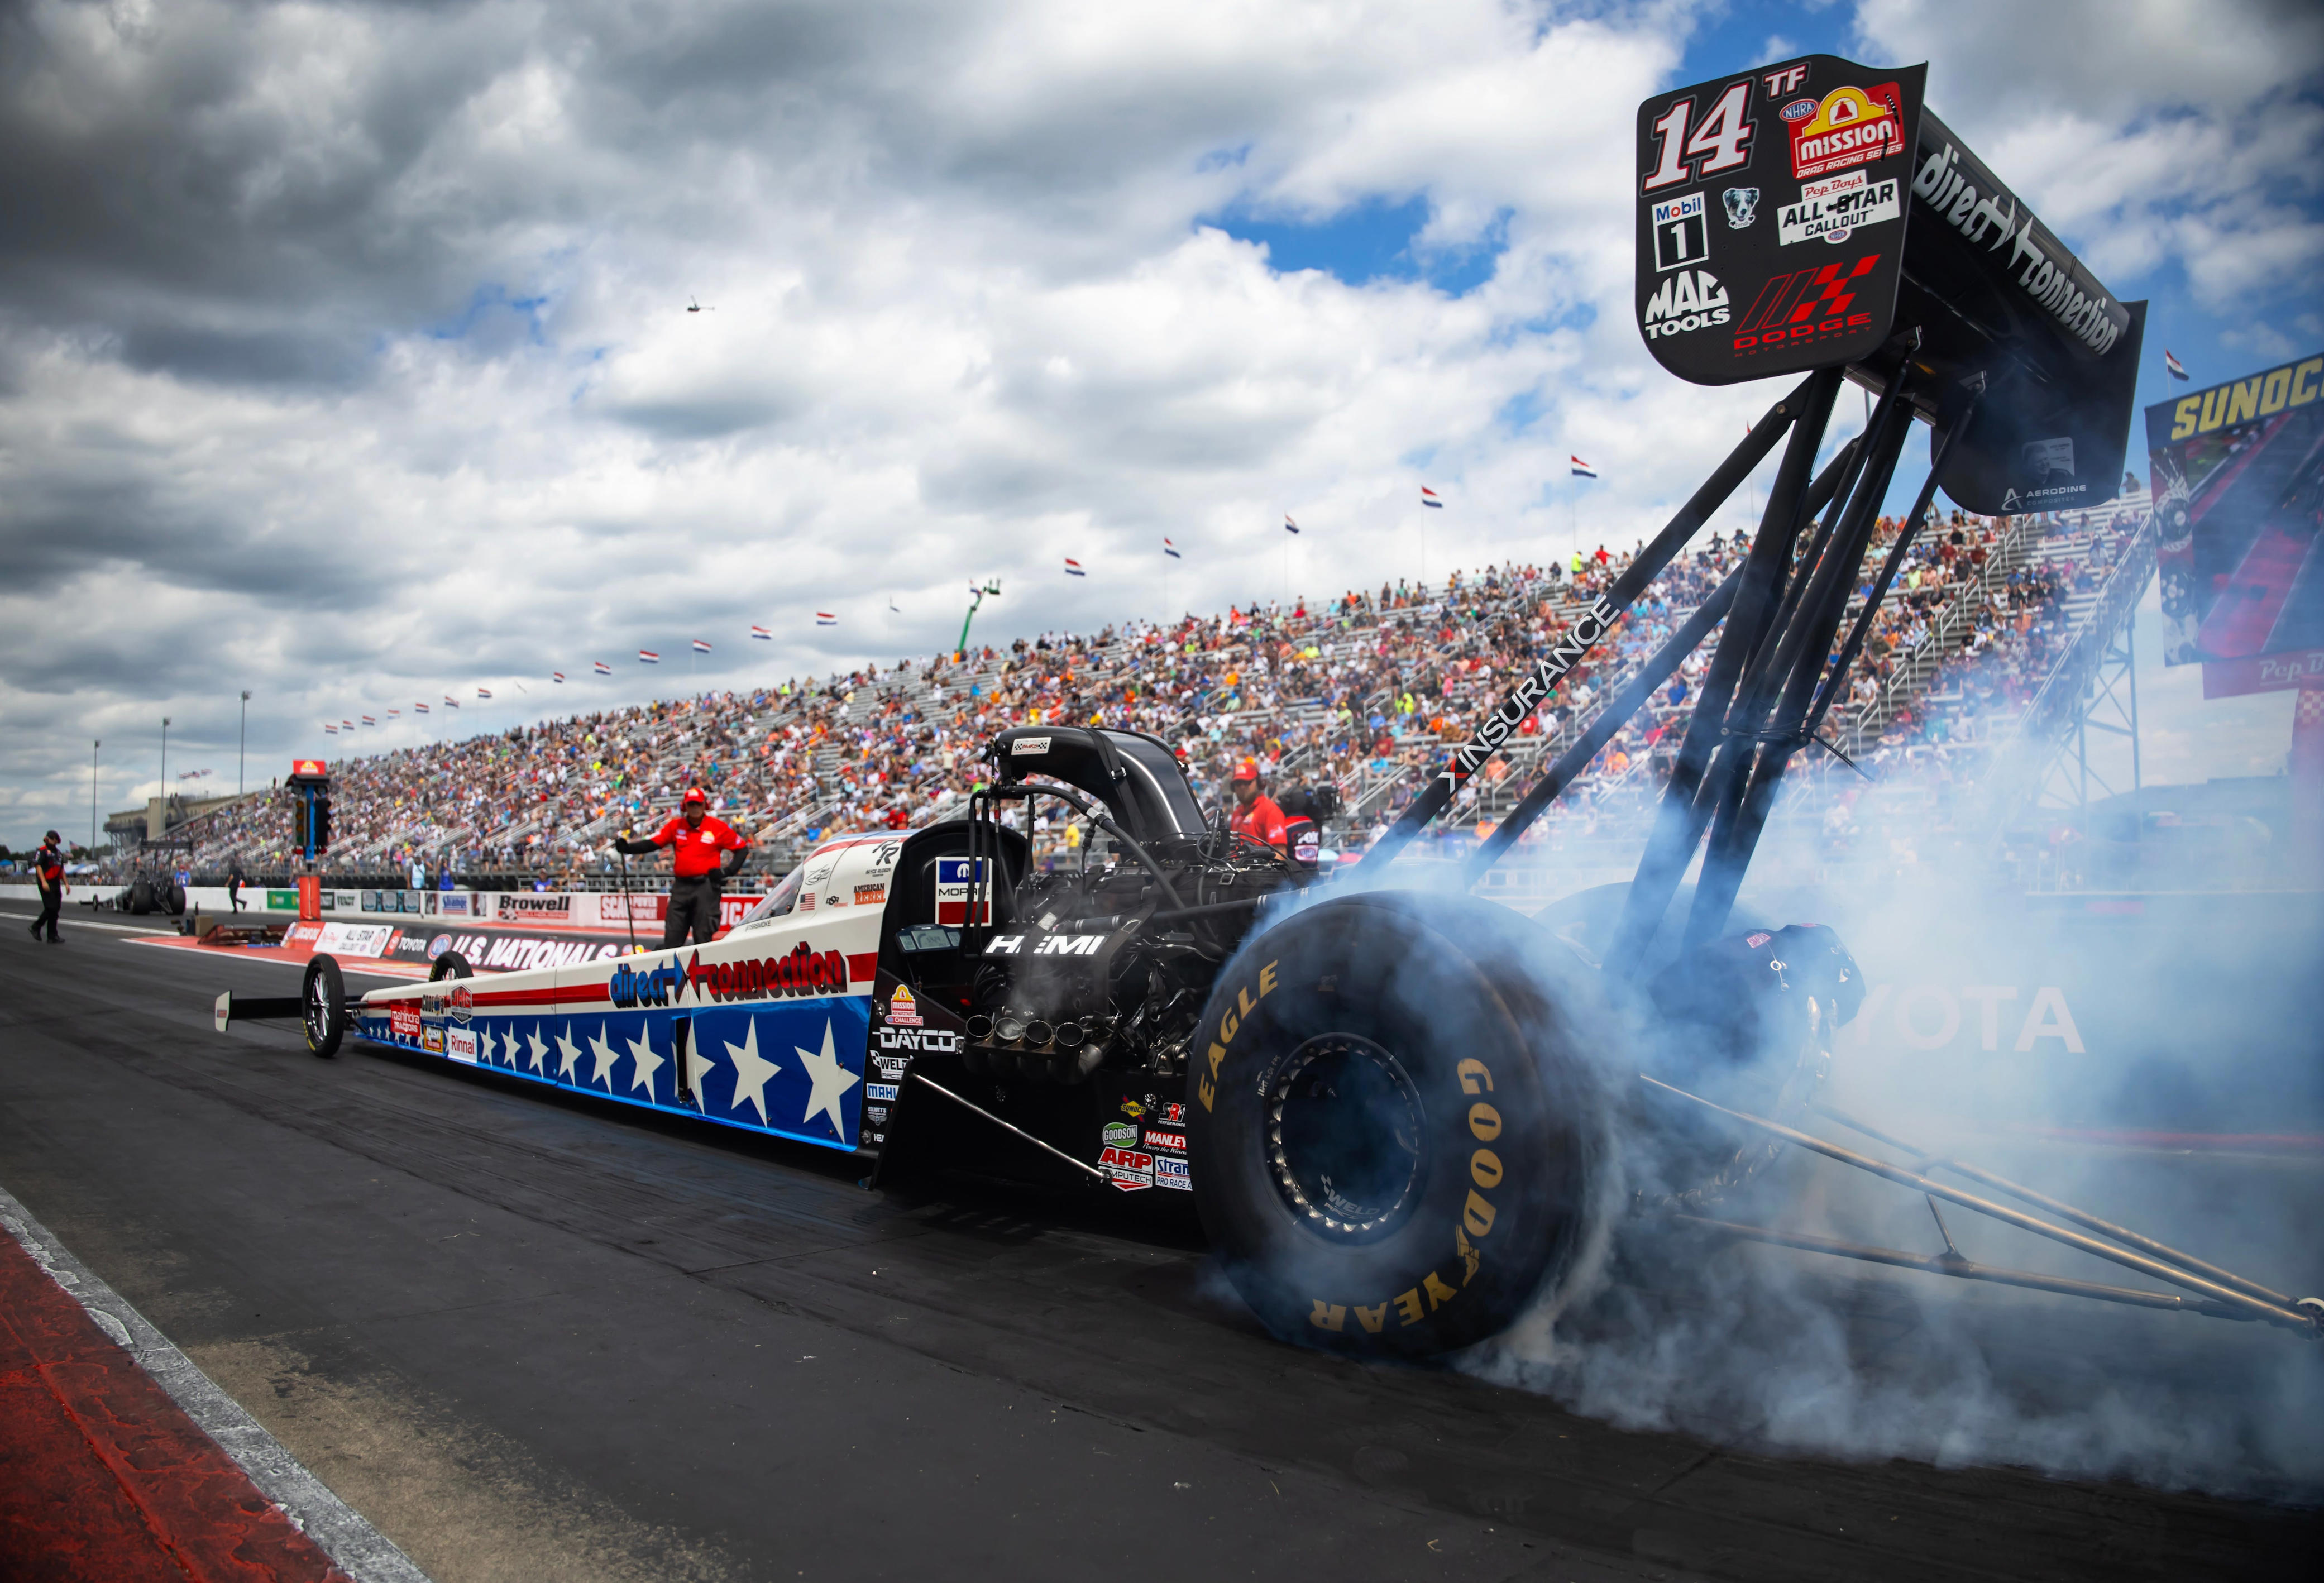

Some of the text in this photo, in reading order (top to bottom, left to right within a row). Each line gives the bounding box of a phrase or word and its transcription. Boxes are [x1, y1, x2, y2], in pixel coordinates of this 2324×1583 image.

[1764, 65, 1808, 97] TF
[1785, 102, 1815, 118] NHRA
[1644, 82, 1752, 191] 14
[1796, 165, 1824, 178] DRAG
[1826, 154, 1864, 170] RACING
[1804, 175, 1863, 197] Pep Boys
[1912, 142, 2010, 250] direct
[1656, 197, 1701, 222] Mobil
[1805, 211, 1869, 236] CALLOUT
[1671, 222, 1687, 260] 1
[1645, 270, 1729, 324] MAC
[2009, 218, 2118, 356] connection
[1645, 308, 1730, 339] TOOLS
[1734, 313, 1871, 350] DODGE
[1734, 327, 1871, 357] MOTORSPORT
[2171, 357, 2324, 442] SUNOC
[2026, 485, 2087, 498] AERODINE
[2027, 496, 2075, 506] COMPOSITES
[854, 883, 885, 893] AMERICAN
[854, 890, 886, 905] REBEL
[499, 895, 570, 911] Browell
[398, 936, 427, 952] TOYOTA
[610, 941, 847, 1008] direct connection
[392, 1010, 419, 1024] mahindra
[394, 1021, 418, 1032] TRACTORS
[451, 1035, 474, 1055] Rinnai
[879, 1027, 956, 1052] DAYCO
[1198, 959, 1279, 1113] EAGLE
[1122, 1104, 1145, 1114] SUNOCO
[1104, 1127, 1136, 1141] GOODSON
[1145, 1131, 1187, 1148] MANLEY
[1100, 1147, 1153, 1169] ARP
[1157, 1177, 1168, 1185] PRO
[1169, 1179, 1187, 1189] RACE
[1328, 1188, 1381, 1215] WELD
